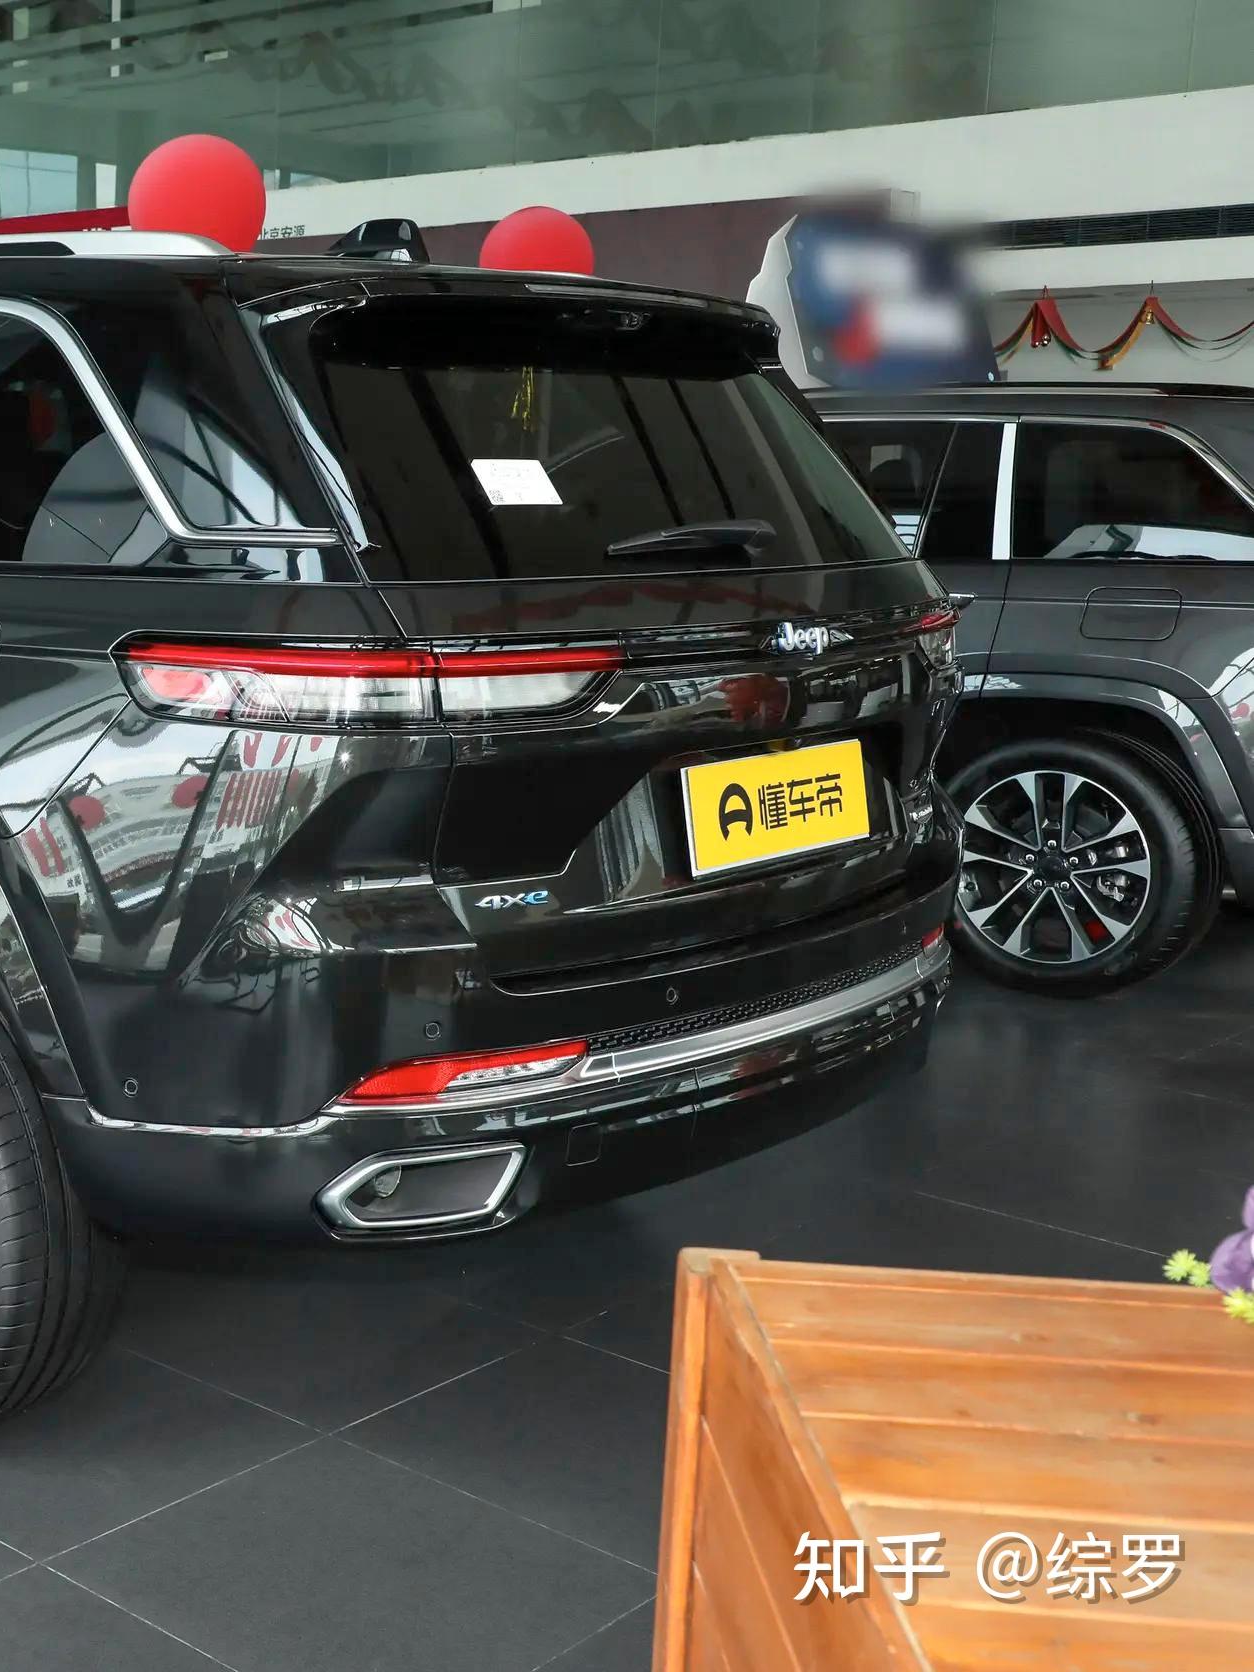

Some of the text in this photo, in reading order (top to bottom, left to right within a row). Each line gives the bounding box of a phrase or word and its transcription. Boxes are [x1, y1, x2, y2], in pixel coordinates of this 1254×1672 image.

[777, 621, 829, 655] Jeep
[758, 774, 843, 831] 懂车帝
